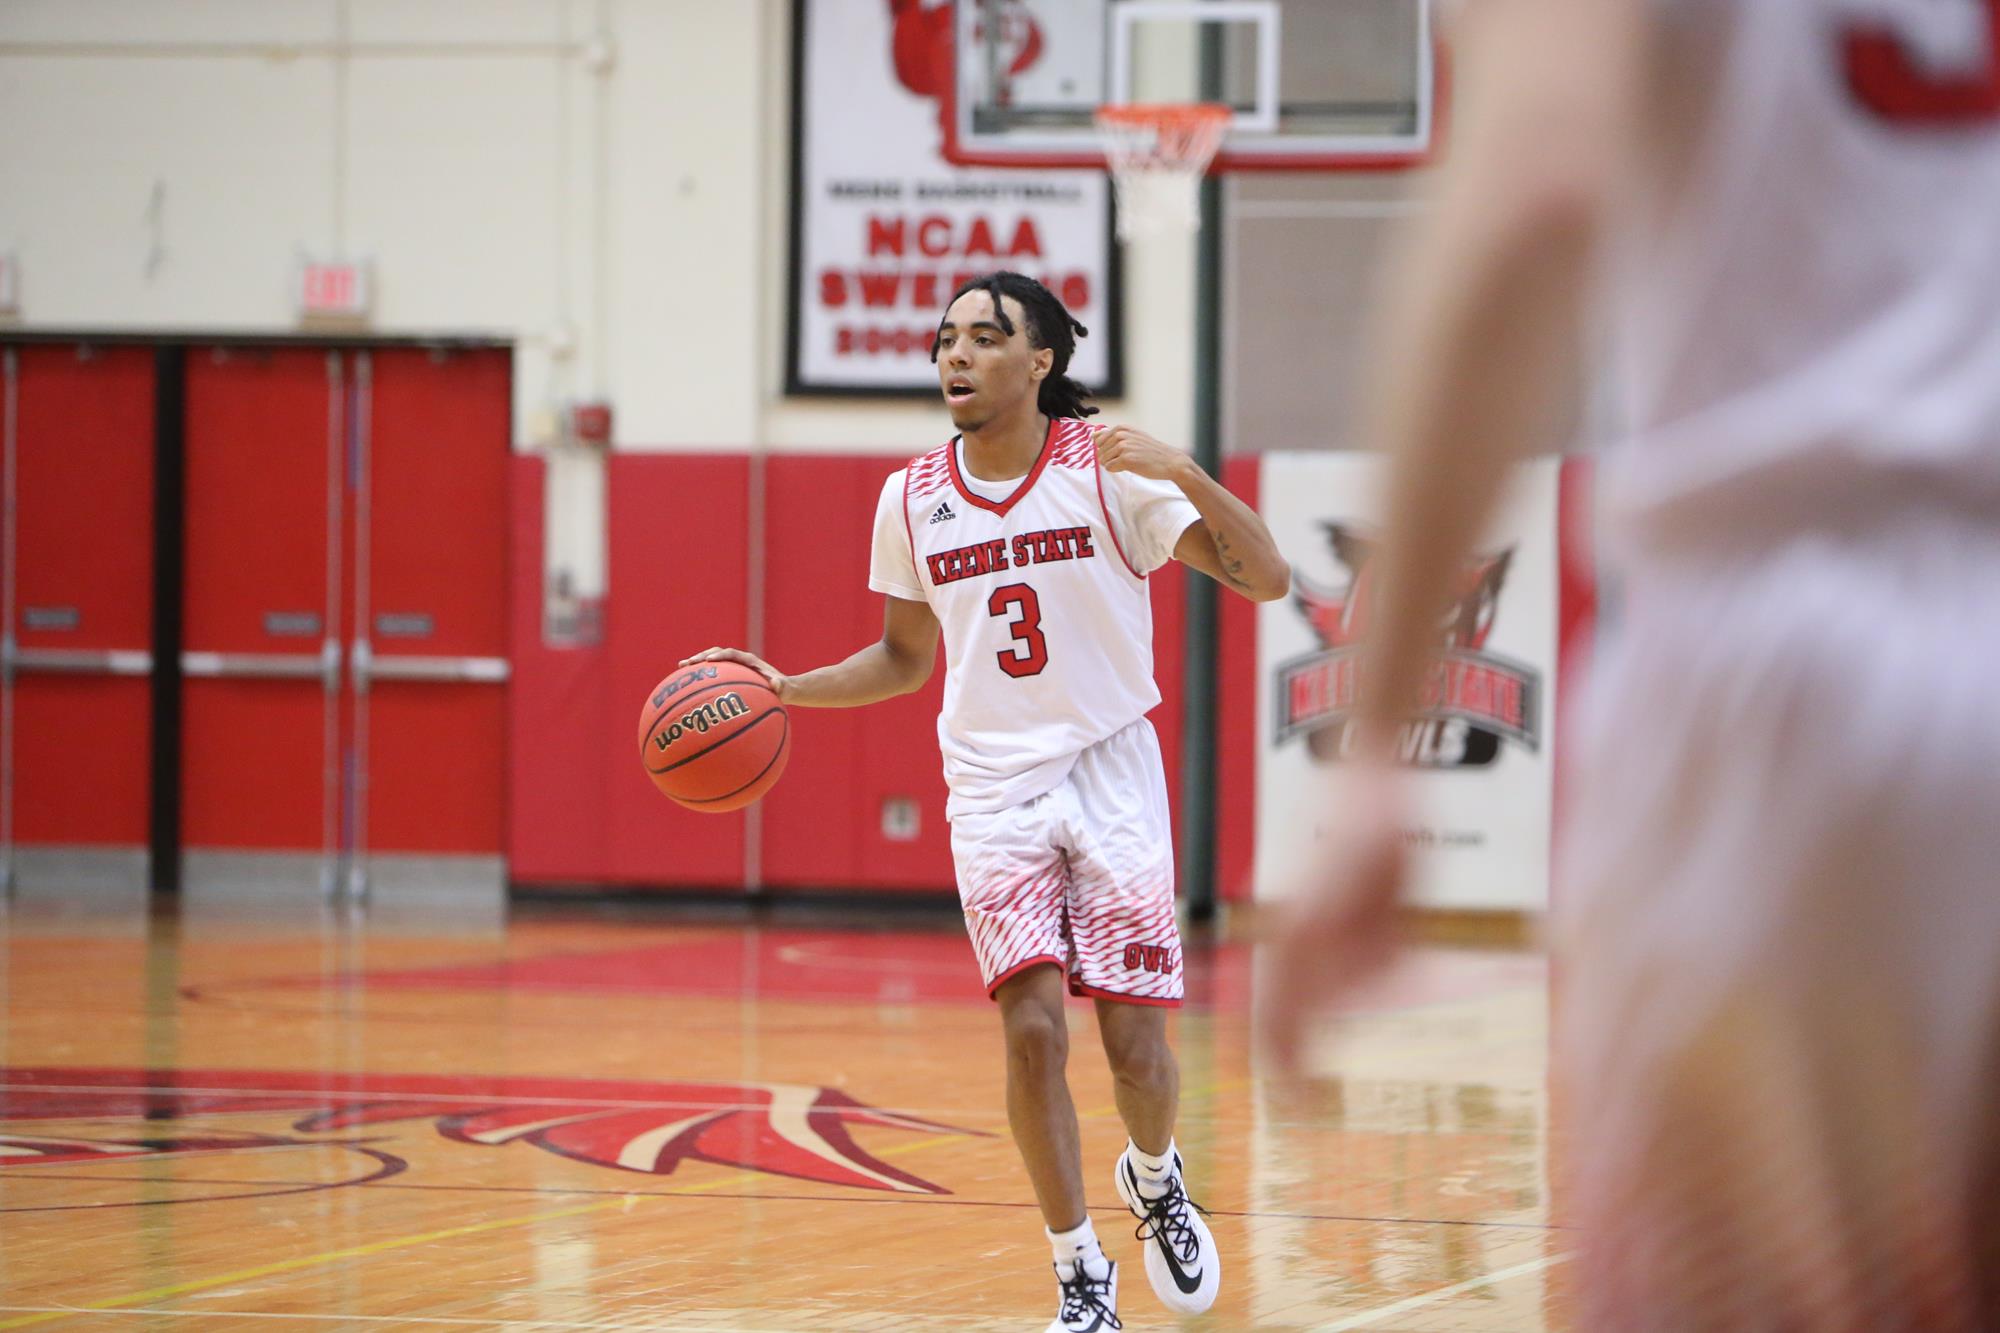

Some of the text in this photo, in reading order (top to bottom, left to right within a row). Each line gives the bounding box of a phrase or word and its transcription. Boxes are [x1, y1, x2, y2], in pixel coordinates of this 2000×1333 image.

[867, 214, 1043, 258] NCAA
[929, 512, 956, 525] adidas
[926, 526, 1095, 586] KEENE STATE
[988, 582, 1049, 678] 3
[654, 691, 751, 752] Wilson
